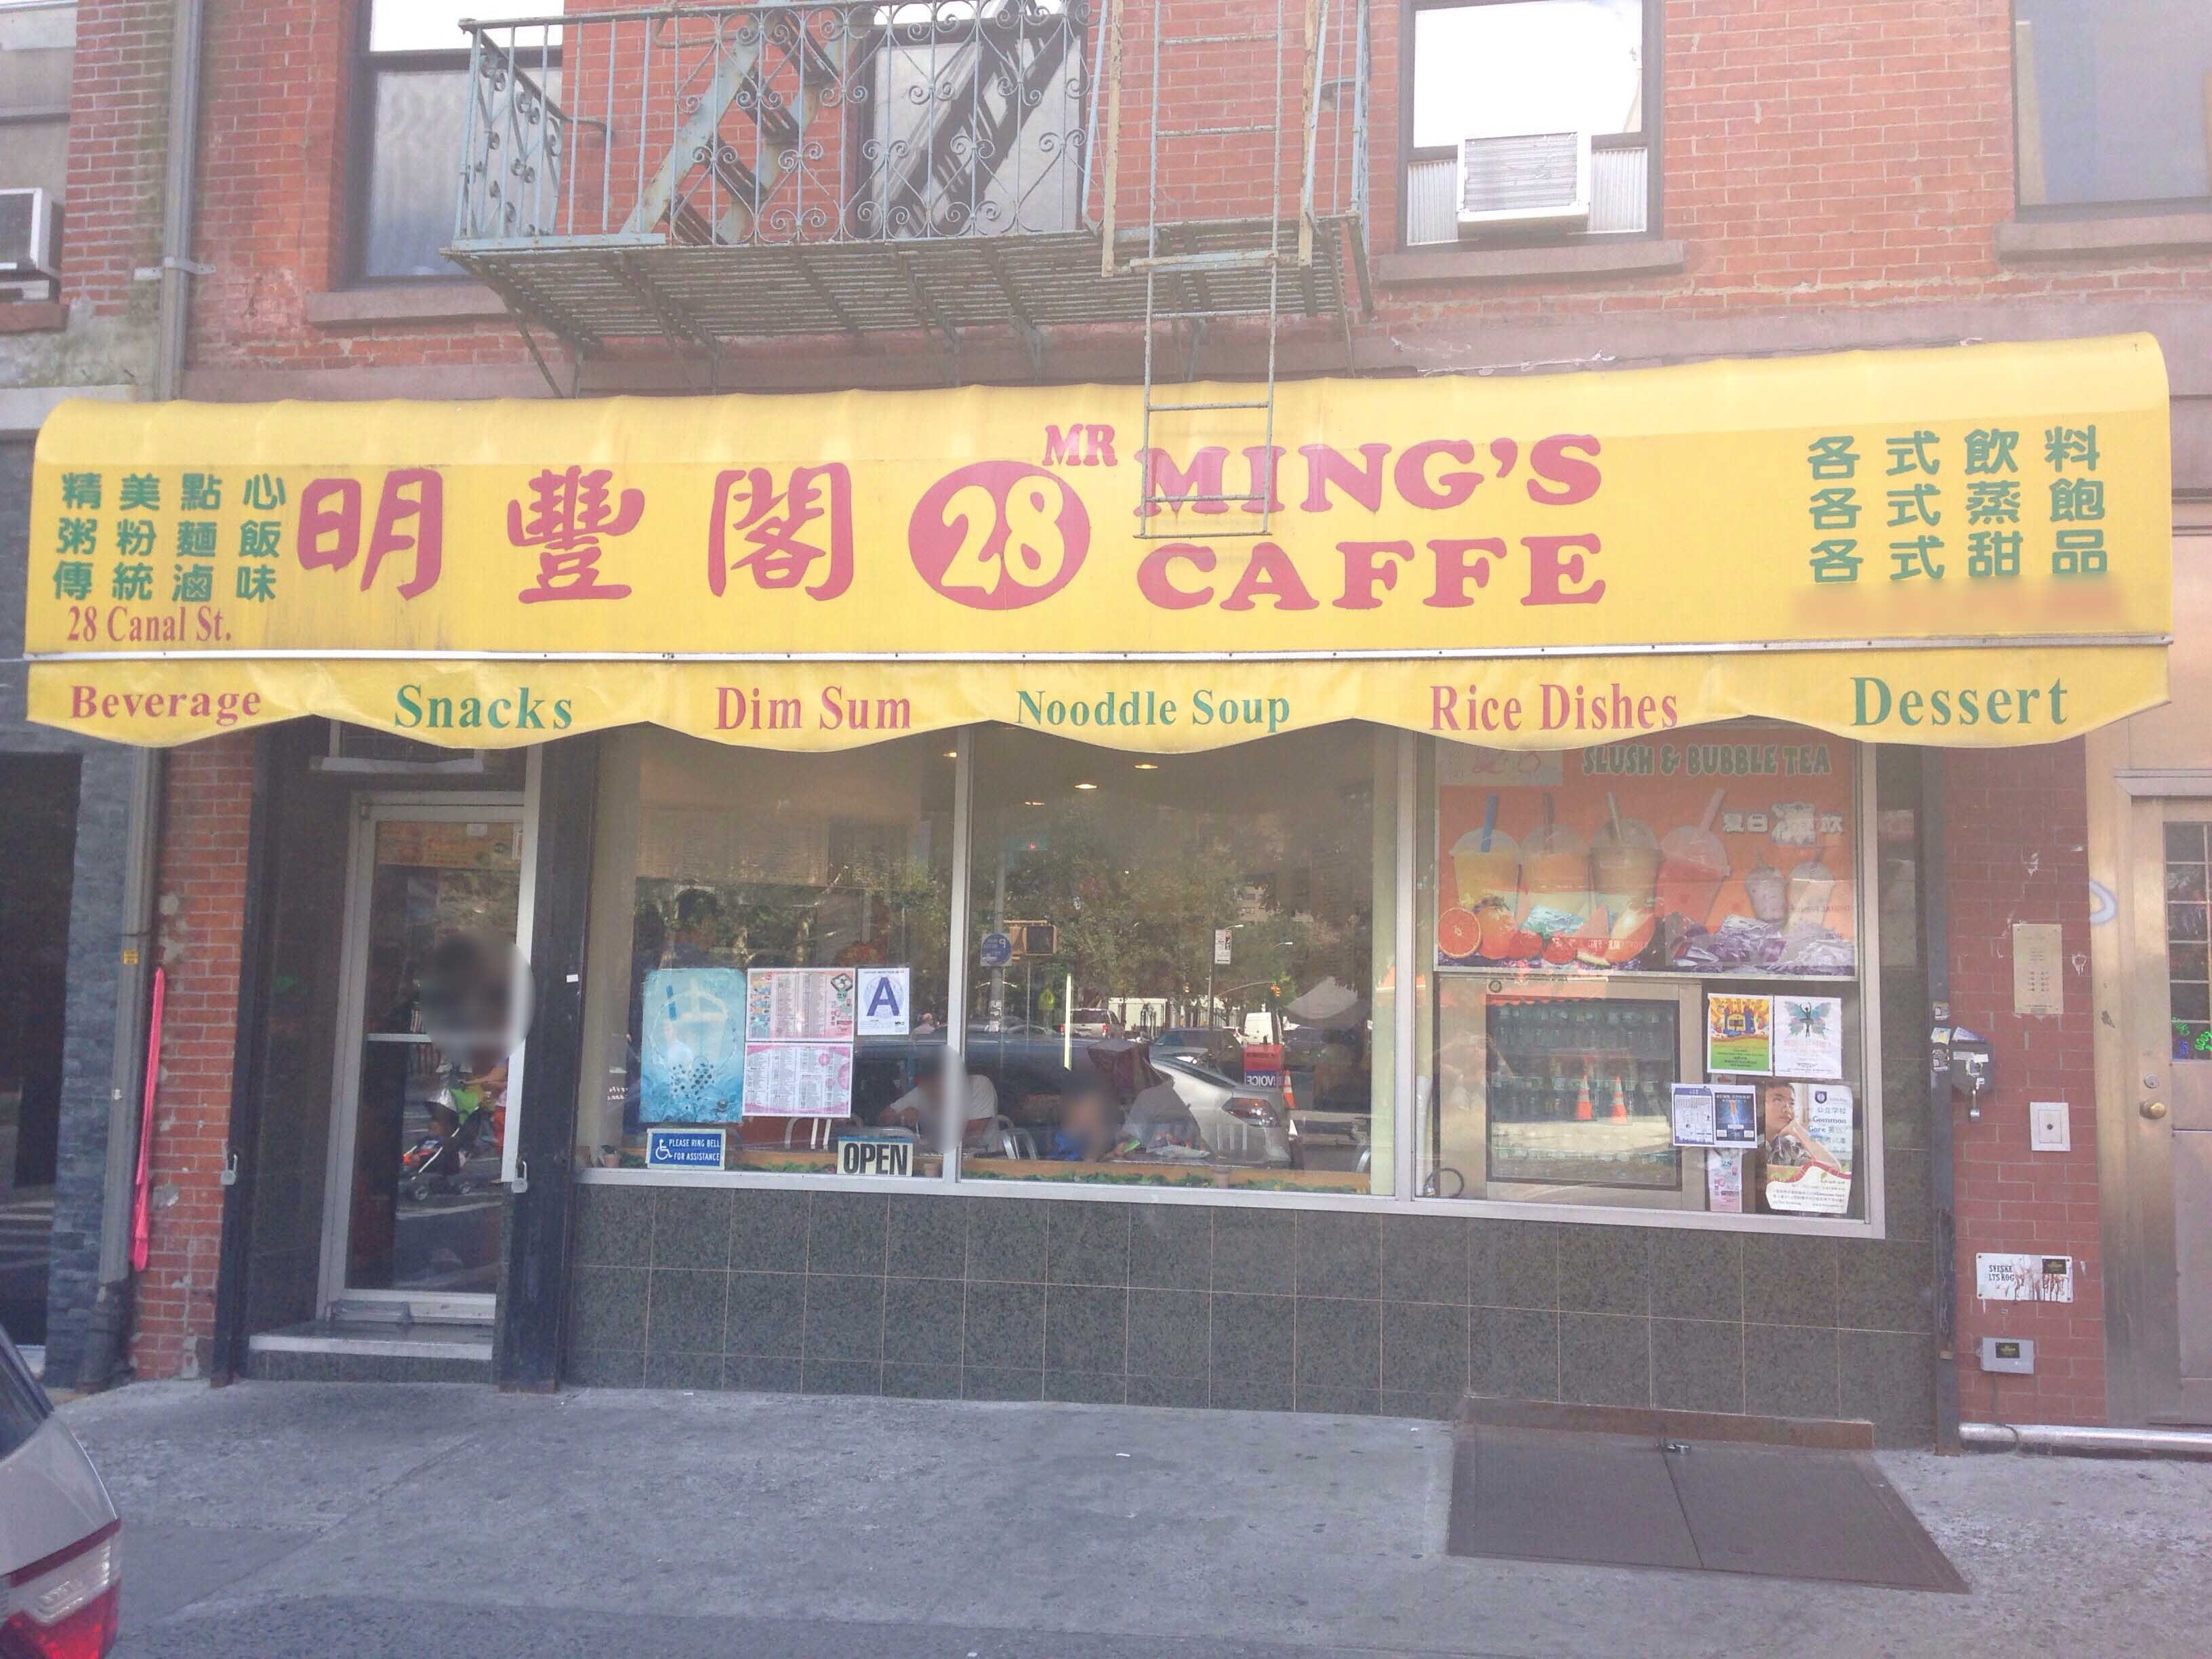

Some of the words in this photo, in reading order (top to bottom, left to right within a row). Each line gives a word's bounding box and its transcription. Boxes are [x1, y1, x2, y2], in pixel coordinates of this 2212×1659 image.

[1042, 424, 1119, 467] MR
[1807, 424, 2101, 480] 各式飲料
[61, 472, 286, 511] 精美點心
[1134, 434, 1602, 516] MING'S
[1809, 477, 2106, 531] 各式蒸飽
[56, 517, 281, 558] 粥粉麵飯
[297, 463, 855, 602] 明豐閣
[940, 475, 1066, 595] 28
[1136, 533, 1607, 611] CAFFE
[1809, 529, 2109, 584] 各式甜品
[52, 562, 276, 602] 傳統滷味
[66, 605, 98, 642] 28
[107, 605, 187, 642] Canal
[196, 605, 232, 641] St.
[70, 684, 262, 725] Beverage
[394, 684, 573, 729] Snacks
[716, 685, 802, 730] Dim
[819, 685, 912, 730] Sum
[1014, 690, 1176, 726] Nooddle
[1191, 689, 1290, 733] Soup
[1430, 684, 1522, 731] Rice
[1539, 683, 1678, 731] Dishes
[1850, 676, 2068, 727] Dessert
[1582, 744, 1654, 776] SLUSH
[1658, 743, 1681, 776] &
[1685, 743, 1779, 776] BUBBLE
[1783, 743, 1832, 776] TEA
[867, 977, 900, 1017] A
[669, 1139, 689, 1147] PLEASE
[707, 1139, 720, 1147] BELL
[674, 1152, 684, 1160] FOR
[686, 1152, 720, 1161] ASSISTANCE
[843, 1143, 908, 1176] OPEN
